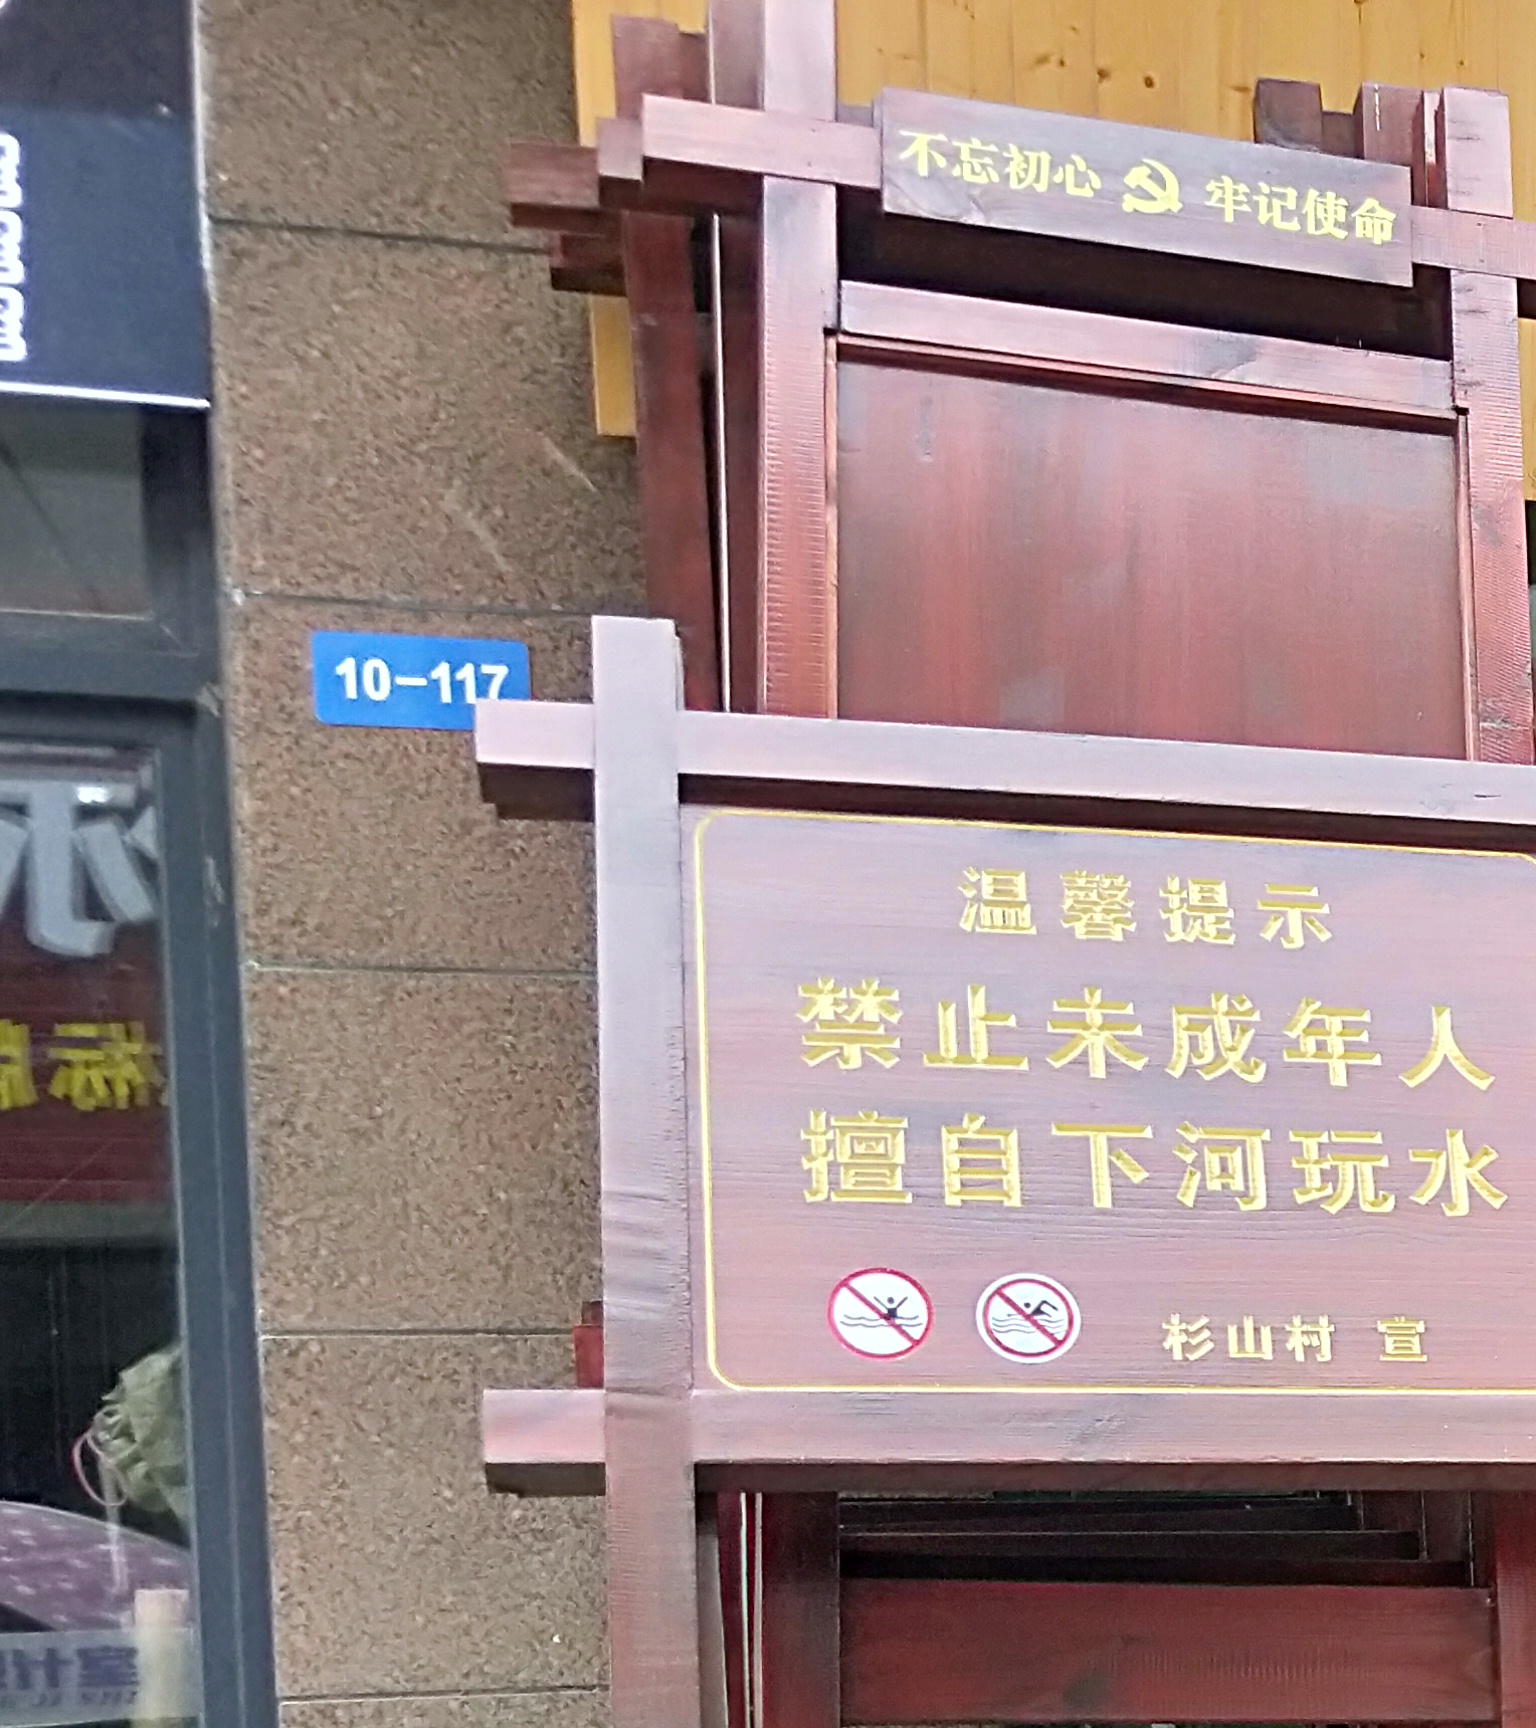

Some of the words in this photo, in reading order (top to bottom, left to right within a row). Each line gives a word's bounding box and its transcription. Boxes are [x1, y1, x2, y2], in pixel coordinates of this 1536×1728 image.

[899, 128, 1102, 200] 不忘初心
[1204, 176, 1398, 246] 牢记使命
[335, 655, 509, 703] 10-117
[958, 866, 1333, 950] 温馨提示
[798, 976, 1496, 1090] 禁止未成年人
[800, 1110, 1508, 1217] 擅自下河玩水
[1161, 1314, 1336, 1363] 杉山村
[1377, 1317, 1428, 1363] 宣
